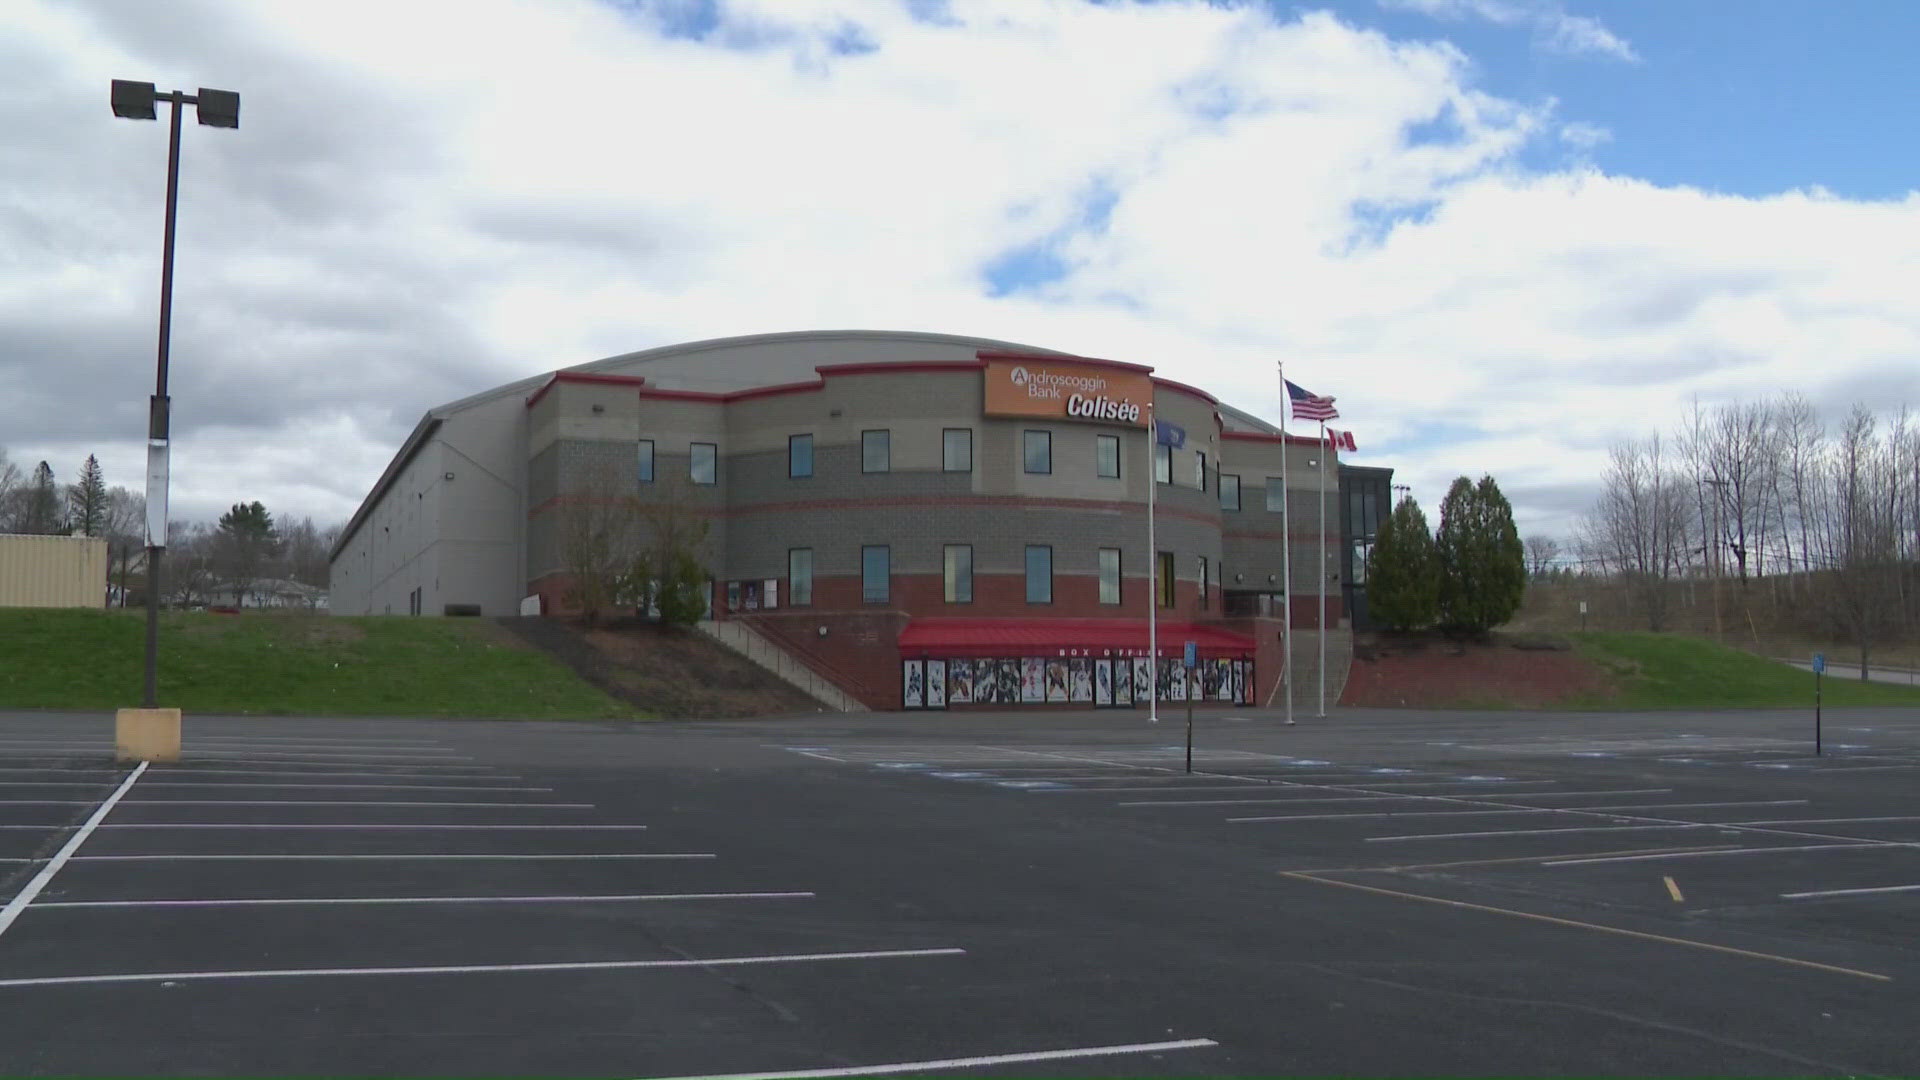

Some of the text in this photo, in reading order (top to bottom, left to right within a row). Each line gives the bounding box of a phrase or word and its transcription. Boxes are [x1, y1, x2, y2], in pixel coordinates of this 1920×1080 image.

[1010, 366, 1106, 392] Androscoggin
[1028, 384, 1061, 399] Bank
[1067, 393, 1140, 422] Colisée
[1059, 648, 1089, 657] BOX
